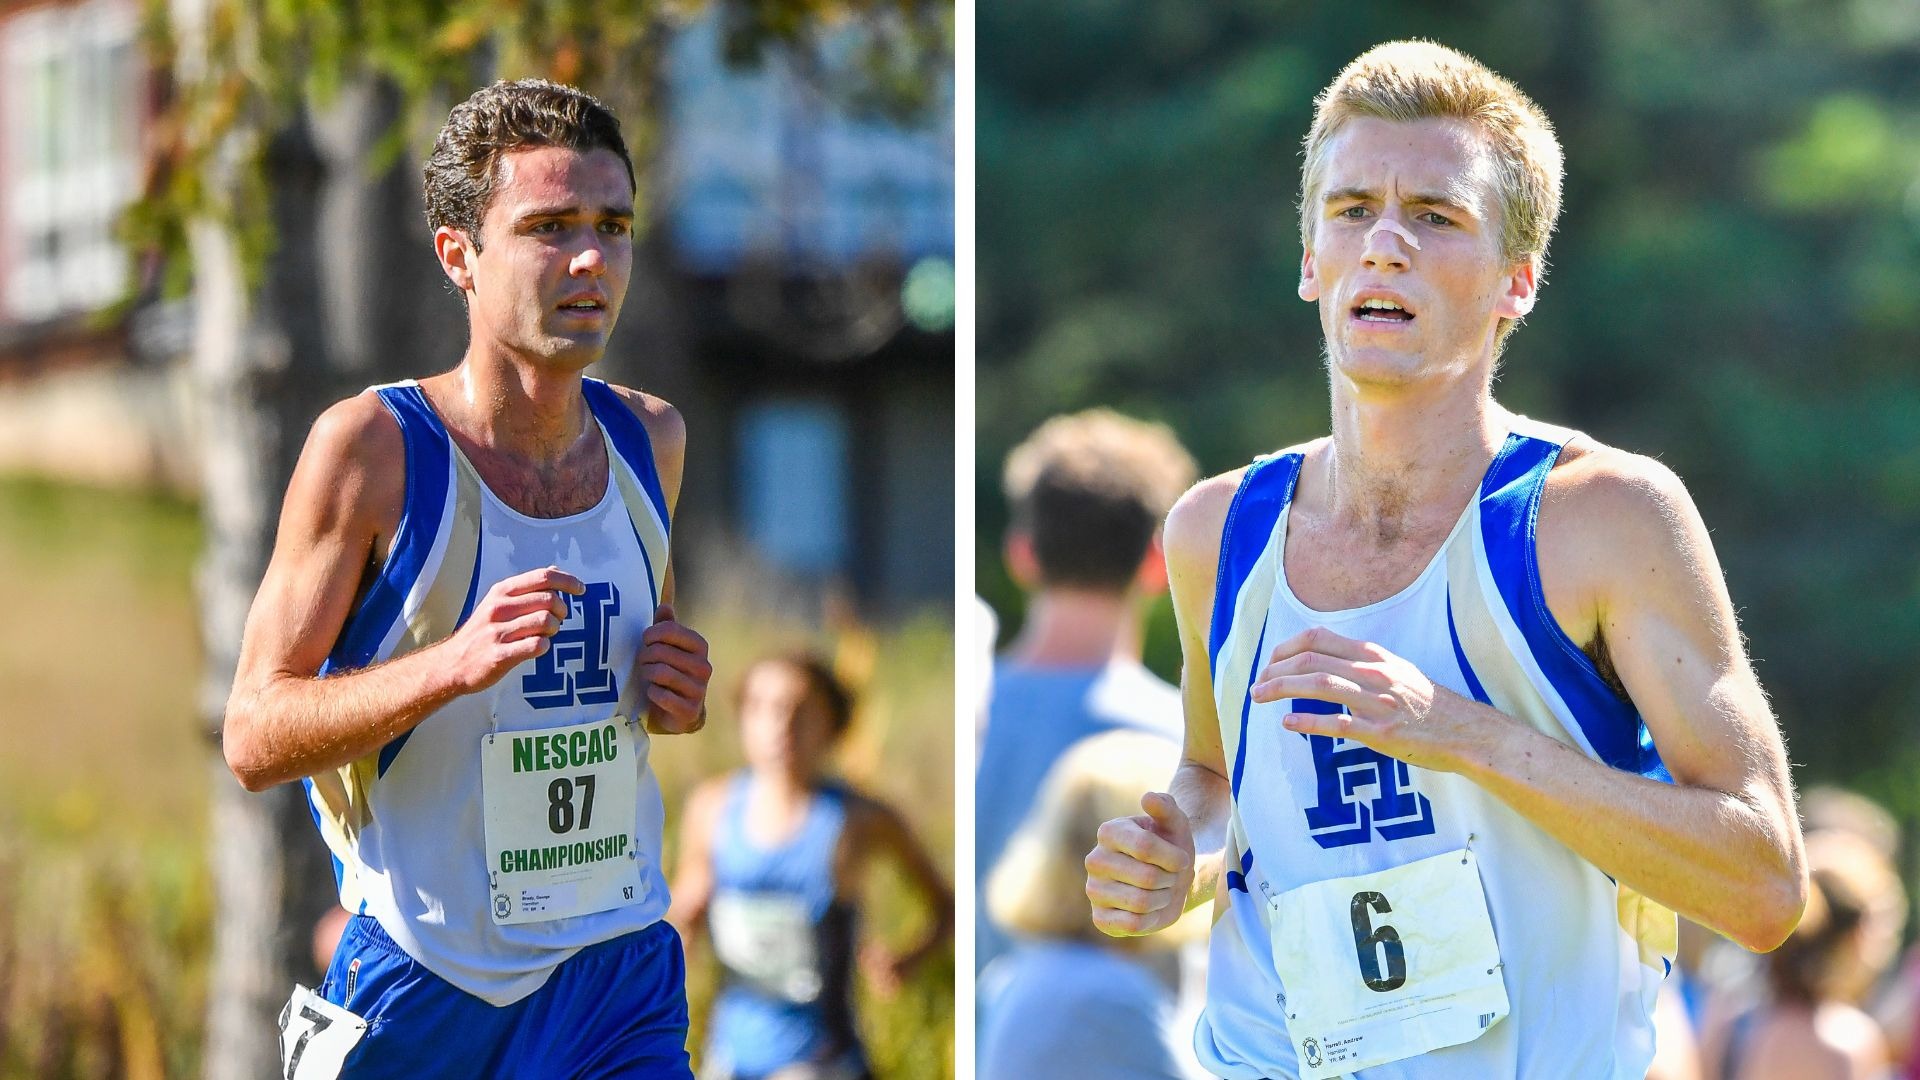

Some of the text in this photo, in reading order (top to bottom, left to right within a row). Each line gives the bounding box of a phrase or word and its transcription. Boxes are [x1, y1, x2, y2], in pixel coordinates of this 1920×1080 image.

[522, 582, 620, 710] H
[512, 725, 618, 773] NESCAC
[547, 774, 597, 835] 87
[500, 834, 628, 873] CHAMPIONSHIP
[622, 886, 634, 900] 87
[1350, 891, 1407, 993] 6
[281, 999, 334, 1080] 7
